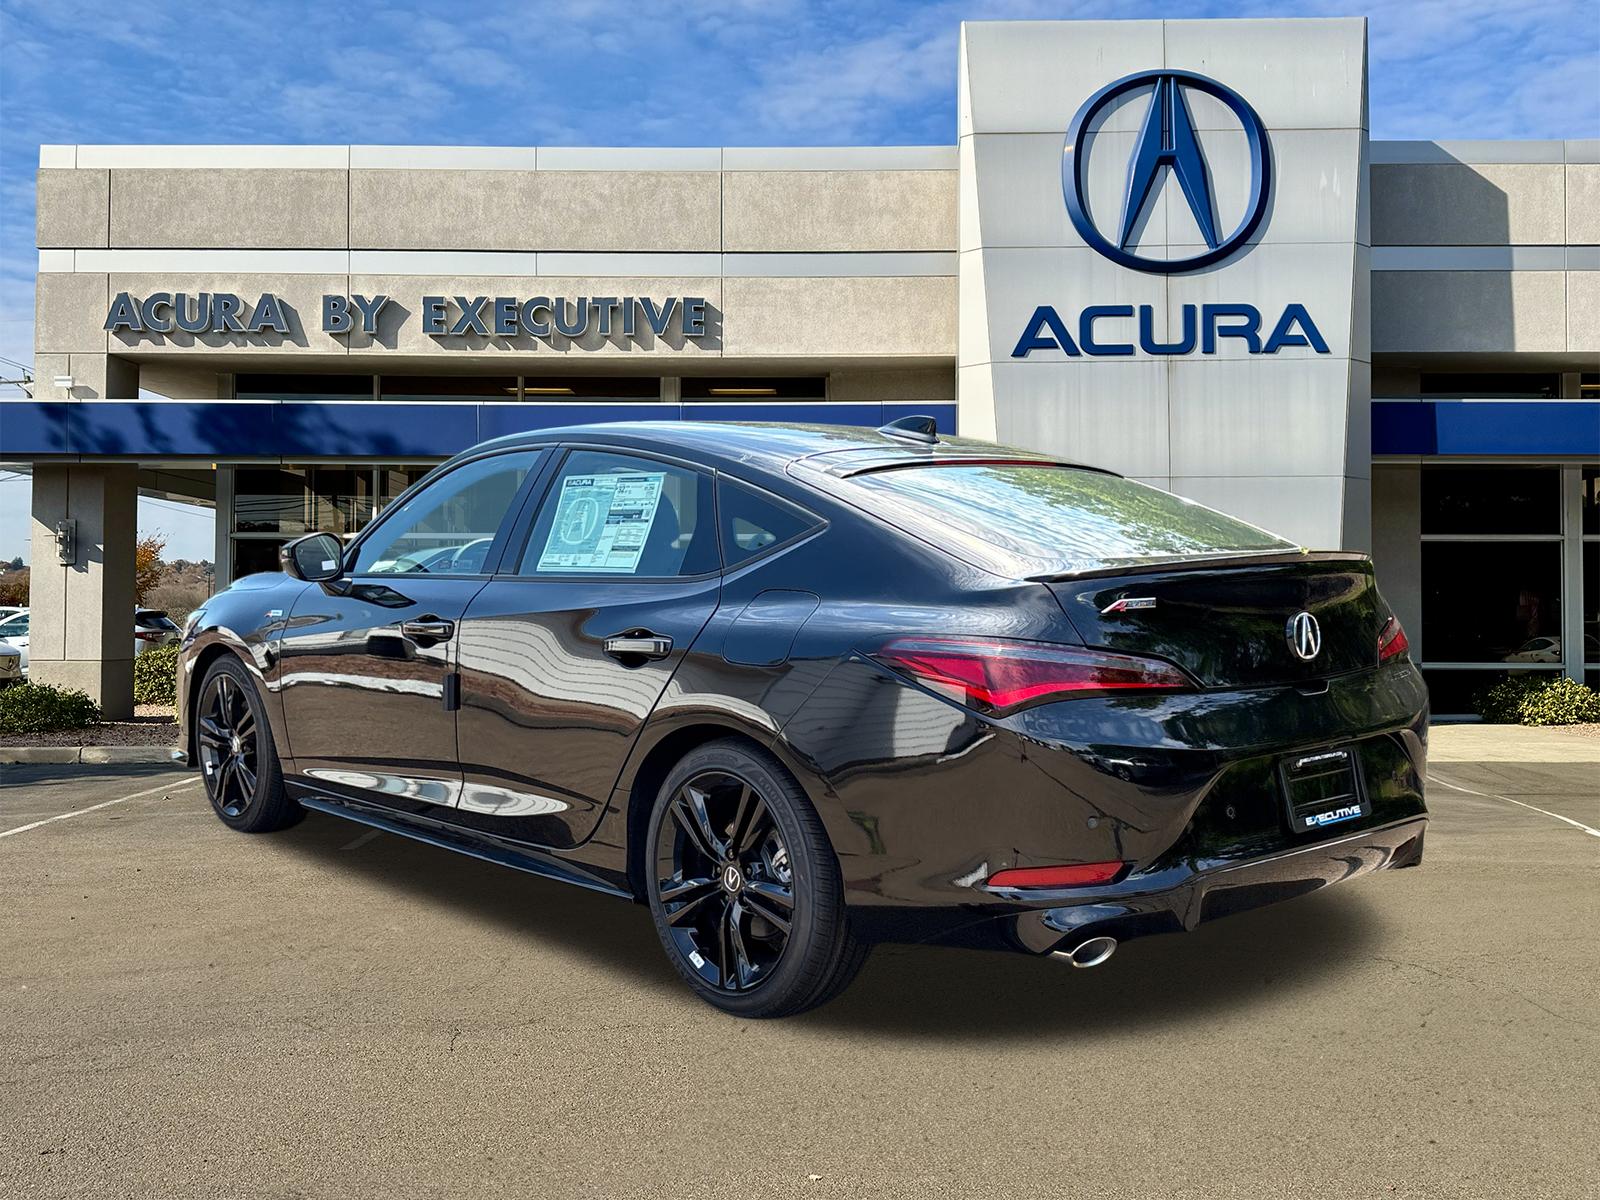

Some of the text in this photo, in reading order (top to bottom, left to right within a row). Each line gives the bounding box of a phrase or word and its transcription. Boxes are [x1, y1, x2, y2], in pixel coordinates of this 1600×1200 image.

[103, 292, 706, 337] ACURA BY EXECUTIVE
[1011, 303, 1332, 357] ACURA
[1305, 805, 1361, 826] EXECUTIVE
